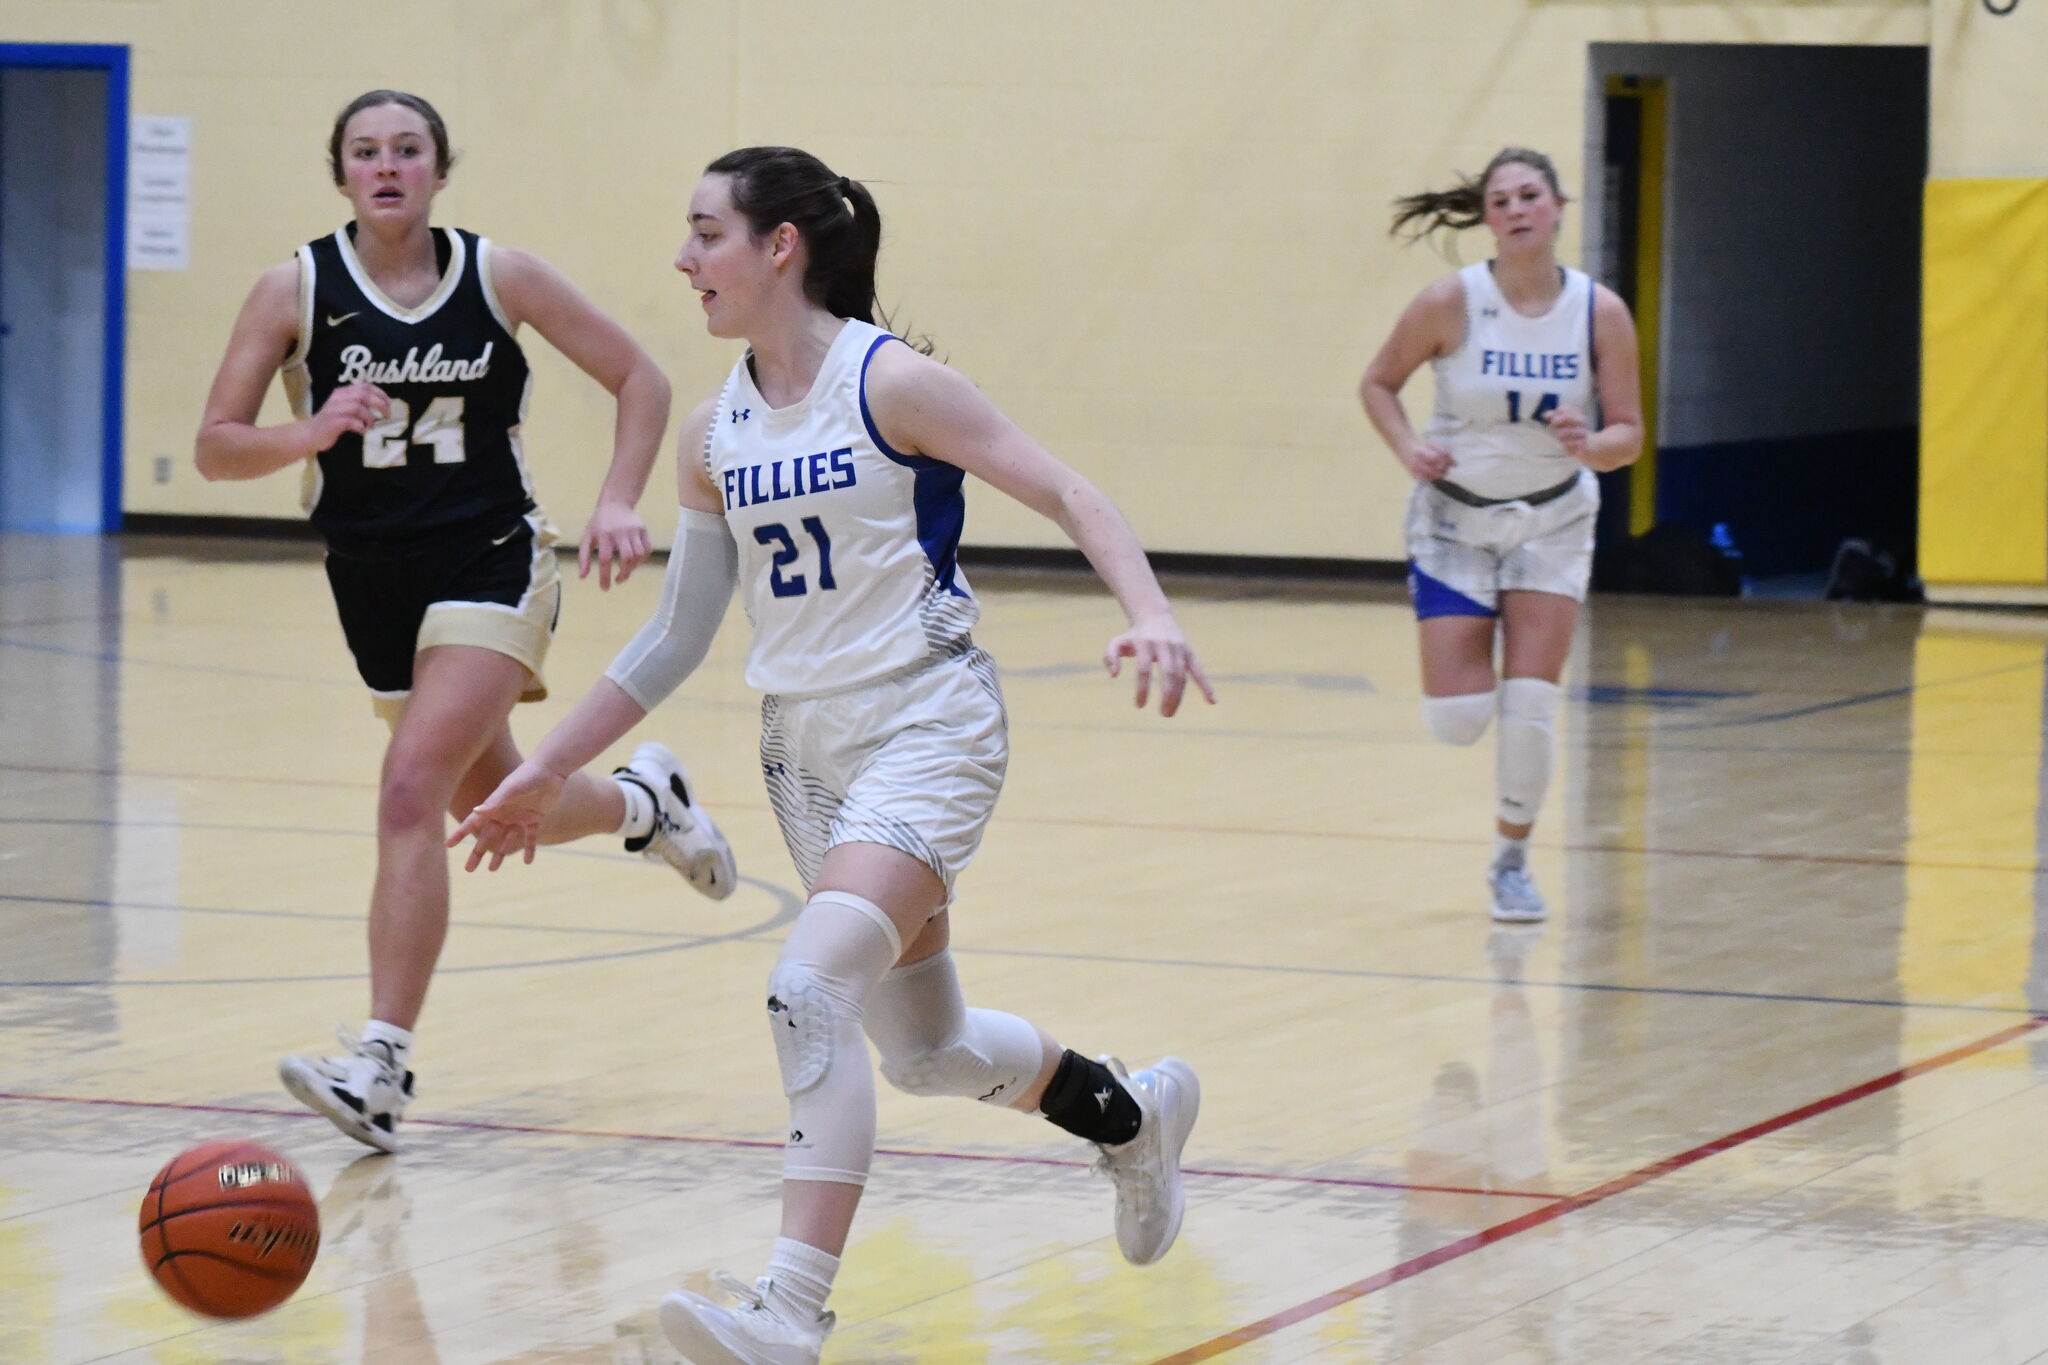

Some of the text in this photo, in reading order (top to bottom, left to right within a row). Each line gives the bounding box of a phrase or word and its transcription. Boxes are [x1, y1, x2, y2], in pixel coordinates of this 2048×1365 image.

[338, 341, 494, 384] Bushland
[1481, 350, 1579, 379] FILLIES
[362, 396, 466, 469] 24
[723, 447, 857, 510] FILLIES
[753, 515, 837, 598] 21
